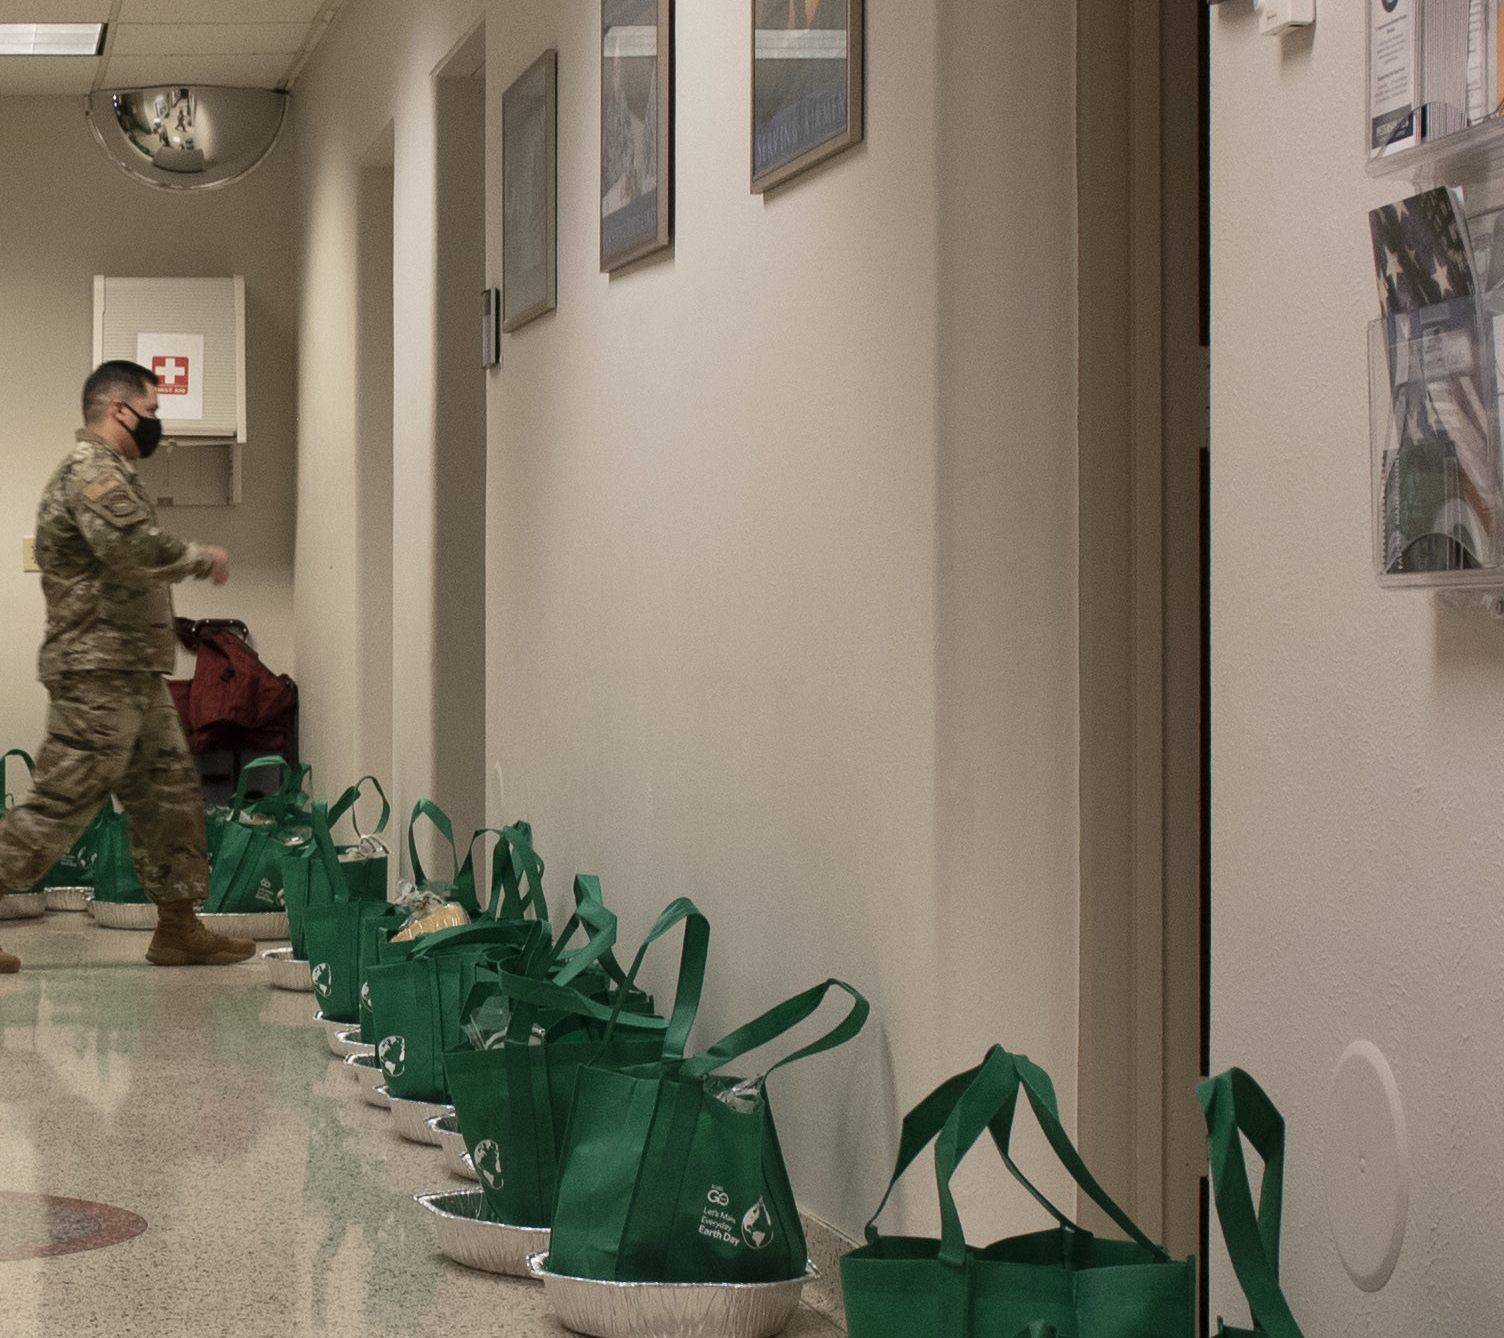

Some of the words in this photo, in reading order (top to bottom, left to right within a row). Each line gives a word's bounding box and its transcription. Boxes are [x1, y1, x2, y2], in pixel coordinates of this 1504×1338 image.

[707, 1189, 730, 1207] GO
[703, 1206, 720, 1218] Let's
[700, 1215, 733, 1233] Everyday
[698, 1224, 723, 1241] Earth
[722, 1232, 740, 1248] Day
